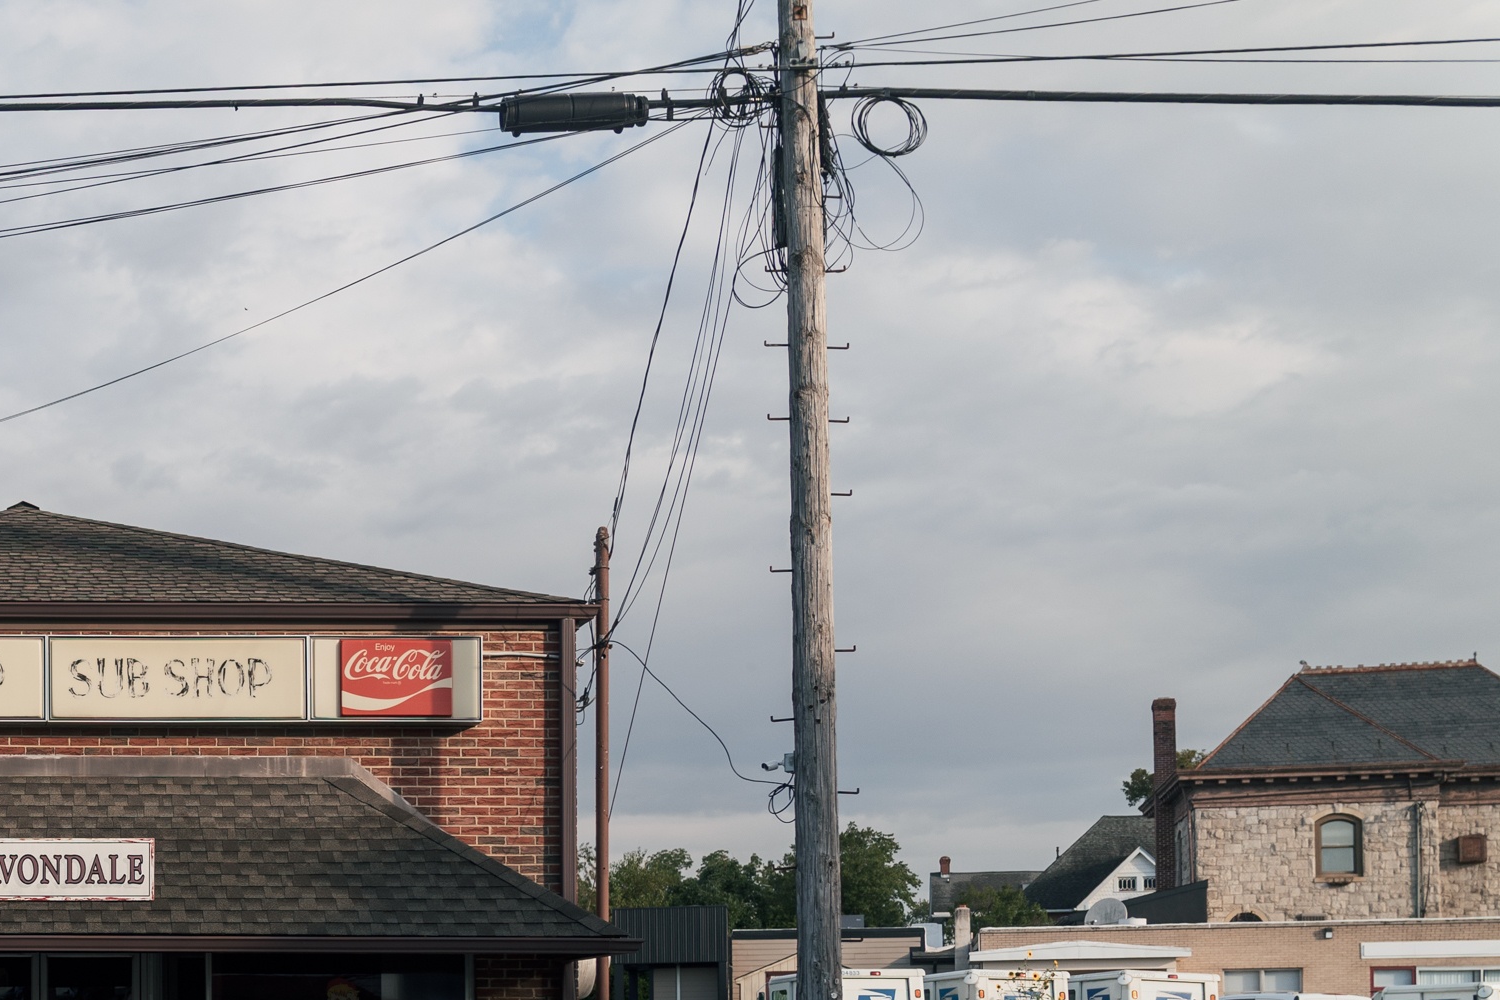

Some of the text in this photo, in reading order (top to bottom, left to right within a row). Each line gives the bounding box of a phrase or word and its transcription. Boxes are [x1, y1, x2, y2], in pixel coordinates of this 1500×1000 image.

[375, 643, 395, 651] Enjoy
[68, 657, 273, 698] SUB SHOP
[344, 649, 446, 680] Coca-Cola
